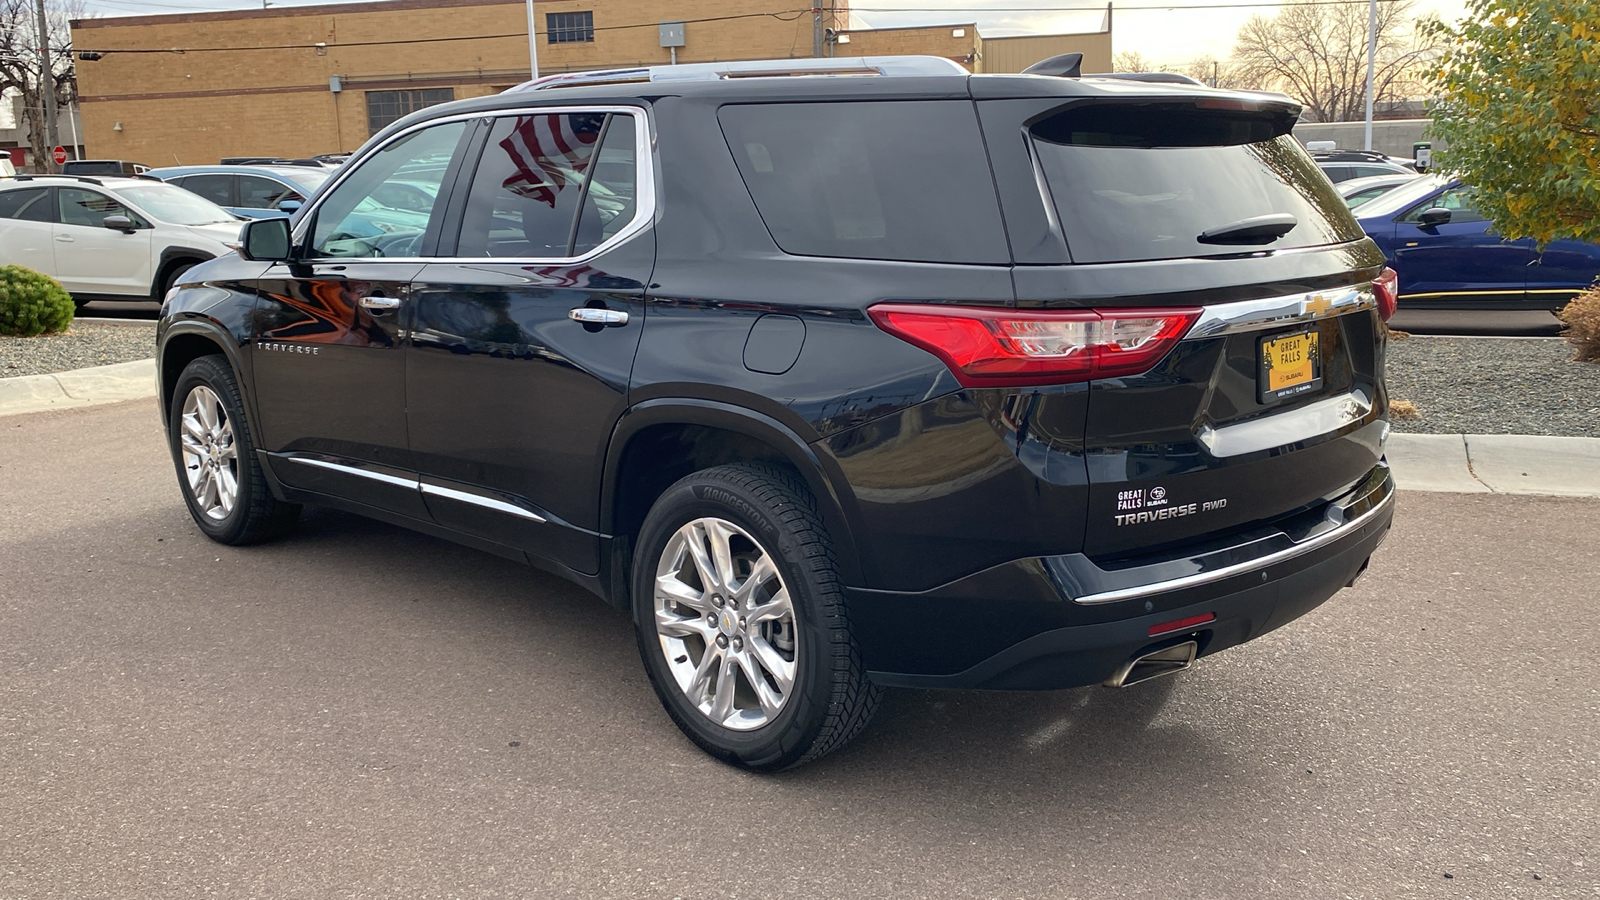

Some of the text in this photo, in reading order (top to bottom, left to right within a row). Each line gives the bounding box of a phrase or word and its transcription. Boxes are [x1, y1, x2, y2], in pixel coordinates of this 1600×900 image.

[54, 151, 66, 159] STOP
[257, 342, 319, 355] TRAVERSE
[1281, 339, 1300, 352] GREAT
[1281, 350, 1301, 365] FALLS
[1285, 371, 1304, 381] SUBARU
[1118, 489, 1142, 501] GREAT
[1117, 498, 1142, 511] FALLS
[1146, 498, 1168, 507] SUBARU
[703, 486, 774, 534] BRIDGESTONE
[1115, 498, 1227, 526] TRAVERSE AWD
